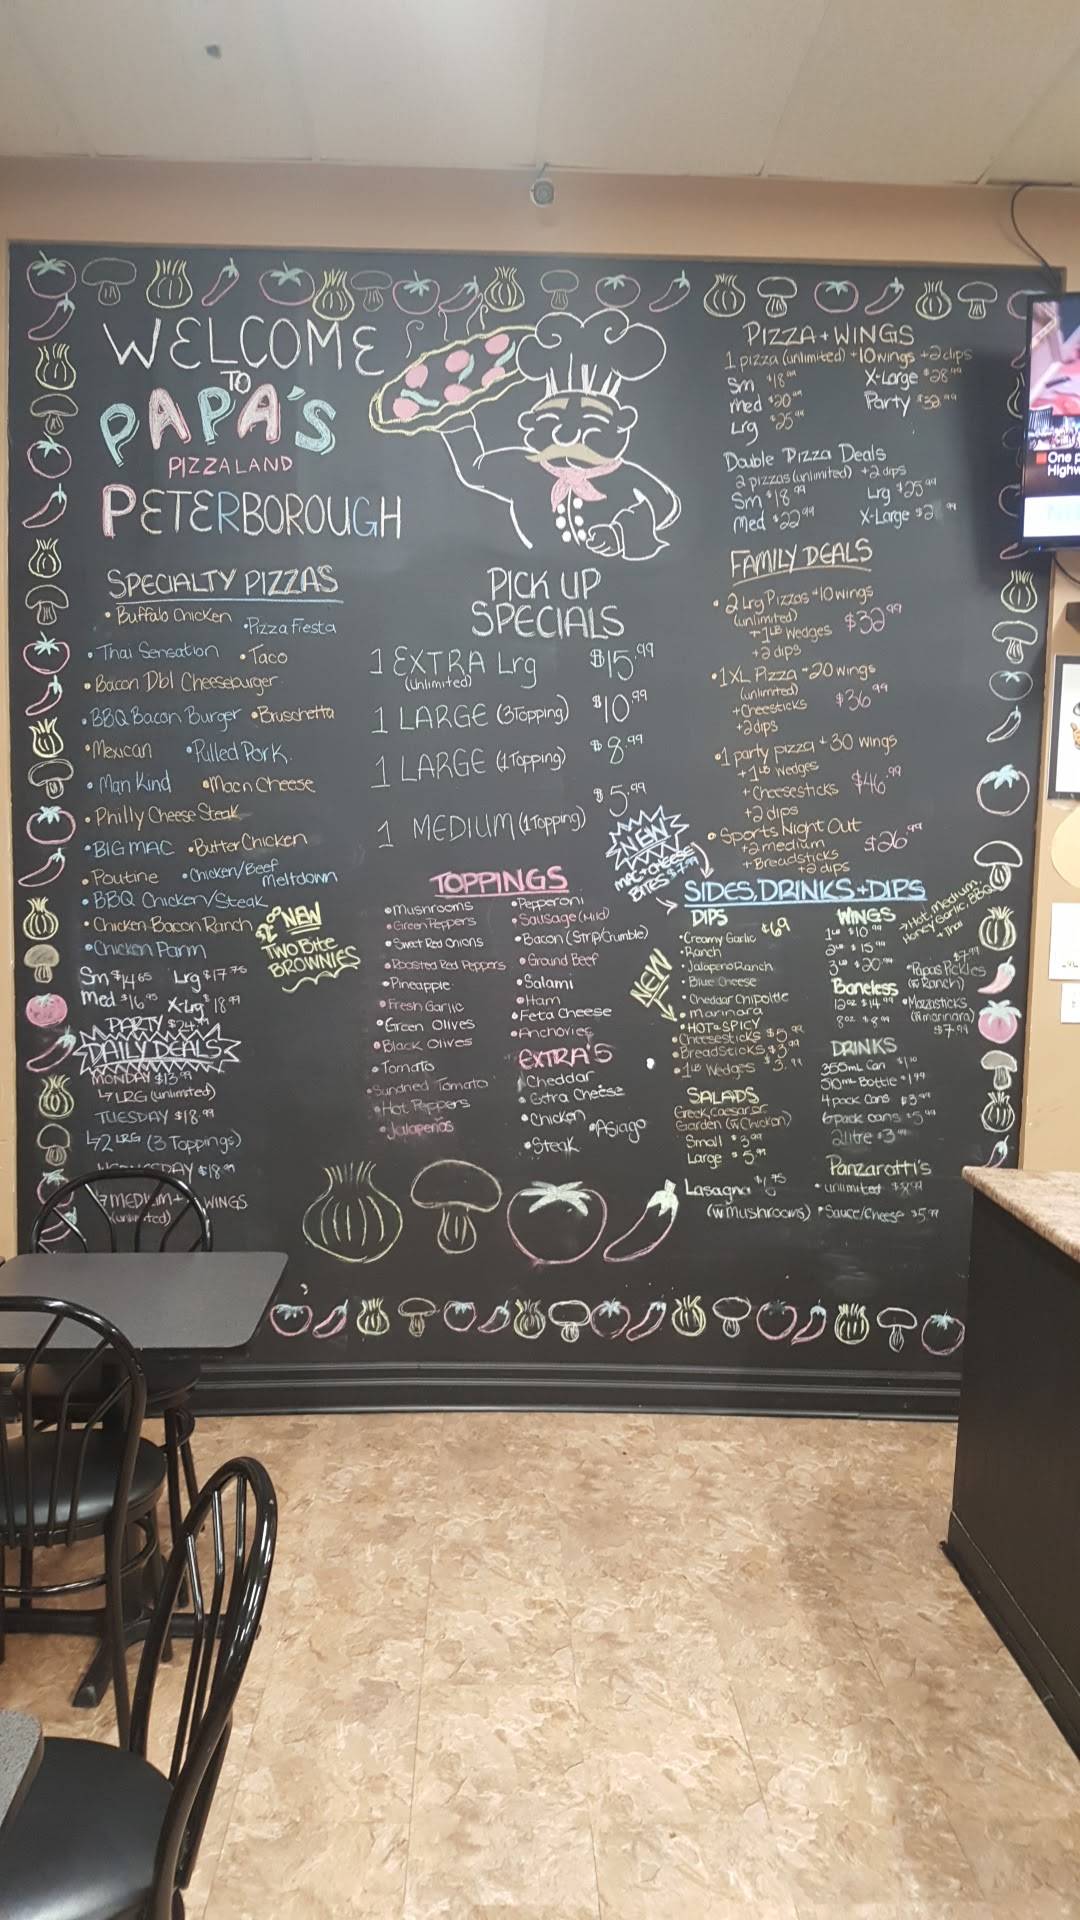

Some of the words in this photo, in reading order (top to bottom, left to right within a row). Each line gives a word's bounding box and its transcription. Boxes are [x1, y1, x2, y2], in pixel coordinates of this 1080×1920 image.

[743, 321, 816, 346] PIZZA
[834, 324, 915, 346] WINGS
[103, 316, 384, 376] WELCOME
[739, 355, 779, 372] pizza
[220, 369, 250, 394] TO
[864, 368, 919, 391] X-Large
[864, 390, 911, 417] Party
[100, 384, 337, 467] PAPA'S
[168, 456, 293, 478] PIZZALAND
[723, 450, 774, 472] Double
[782, 447, 832, 463] Pizza
[839, 443, 887, 463] Deals
[1047, 451, 1072, 465] One
[102, 484, 401, 539] PETERBOROUGH
[860, 507, 910, 530] X-Large
[730, 547, 798, 579] FAMILY
[805, 538, 873, 566] DEALS
[107, 568, 237, 599] SPECIALTY
[245, 565, 339, 595] PIZZAS
[486, 567, 550, 602] PICK
[561, 567, 601, 600] UP
[725, 593, 738, 614] 2
[764, 589, 809, 607] Pizzas
[117, 606, 168, 625] Buffalo
[173, 607, 232, 624] Chicken
[471, 600, 625, 640] SPECIALS
[248, 617, 288, 635] Pizza
[96, 643, 133, 661] Thai
[139, 641, 220, 659] Sensation
[248, 644, 288, 664] Taco
[773, 644, 801, 661] dips
[369, 647, 383, 675] 1
[393, 646, 486, 677] EXTRA
[497, 651, 537, 689] Lrg
[590, 642, 654, 681] $15.99
[95, 674, 139, 693] Bacon
[143, 671, 174, 692] Dbl
[181, 671, 279, 697] Cheeseburger
[90, 707, 129, 729] BBQ
[131, 706, 182, 726] Bacon
[185, 706, 242, 732] Burger
[257, 705, 336, 725] Bruschetta
[371, 706, 389, 734] 1
[400, 703, 489, 730] LARGE
[592, 689, 648, 724] $10.99
[92, 740, 153, 760] Mexican
[192, 739, 240, 763] Pulled
[241, 741, 288, 764] Pork
[734, 744, 769, 768] party
[774, 740, 815, 763] pizza
[370, 755, 391, 789] 1
[401, 748, 486, 782] LARGE
[99, 774, 131, 796] Man
[136, 770, 172, 793] Kind
[256, 777, 316, 793] Cheese
[95, 806, 144, 832] Philly
[149, 806, 197, 824] Cheese
[198, 803, 241, 822] Steak
[377, 820, 394, 848] 1
[413, 812, 516, 842] MEDIUM
[619, 817, 672, 855] NEW
[720, 825, 779, 845] Sports
[782, 821, 824, 841] Night
[828, 818, 863, 834] Out
[93, 840, 125, 859] BIG
[130, 840, 176, 857] MAC
[194, 838, 240, 857] Butter
[241, 833, 308, 851] Chicken
[91, 868, 160, 887] Poutine
[430, 866, 569, 894] TOPPINGS
[628, 873, 670, 902] BITES
[758, 877, 855, 900] DRINKS
[866, 878, 926, 899] DIPS
[93, 890, 136, 910] BBQ
[391, 901, 474, 916] Mushrooms
[516, 896, 584, 911] Pepperoni
[93, 917, 147, 933] Chicken
[150, 915, 202, 935] Bacon
[202, 915, 253, 933] Ranch
[281, 902, 323, 929] NEW
[393, 921, 428, 931] Green
[429, 916, 477, 931] Peppers
[519, 912, 577, 926] Sausage
[691, 908, 728, 927] DIPS
[837, 907, 896, 926] WINGS
[426, 938, 443, 948] Red
[445, 936, 484, 949] Onions
[522, 932, 564, 947] Bacon
[684, 931, 723, 947] Creamy
[726, 931, 756, 943] Garlic
[93, 941, 153, 957] Chicken
[156, 941, 207, 959] Parm
[528, 953, 568, 967] Ground
[570, 952, 599, 966] Beef
[685, 946, 721, 957] Ranch
[267, 950, 361, 979] BROWNIES
[392, 959, 438, 971] Roasted
[439, 960, 459, 970] Red
[462, 959, 506, 972] Peppers
[390, 977, 451, 992] Pineapple
[524, 975, 574, 990] Salami
[629, 948, 673, 1008] NEW
[689, 976, 716, 987] Blue
[718, 976, 757, 987] Cheese
[831, 978, 899, 996] Boneless
[388, 1000, 423, 1012] Fresh
[425, 998, 464, 1014] Garlic
[524, 994, 561, 1006] Ham
[520, 1008, 555, 1022] Feta
[558, 1006, 613, 1019] Cheese
[104, 1015, 164, 1033] PARTY
[384, 1017, 424, 1034] Green
[431, 1015, 476, 1030] Olives
[518, 1025, 593, 1039] Anchovies
[722, 1017, 761, 1033] SPICY
[87, 1039, 148, 1067] DAILY
[152, 1038, 222, 1060] DEALS
[382, 1039, 423, 1052] Black
[427, 1037, 473, 1050] Olives
[831, 1037, 898, 1057] DRINKS
[381, 1060, 436, 1074] Tomato
[91, 1072, 151, 1085] MONDAY
[436, 1077, 489, 1091] Tomato
[526, 1071, 597, 1089] Cheddar
[115, 1090, 148, 1103] LRG
[573, 1085, 626, 1101] Cheese
[687, 1086, 760, 1104] SALADS
[95, 1110, 169, 1125] TUESDAY
[382, 1100, 409, 1116] Hot
[530, 1109, 586, 1127] Chicken
[676, 1115, 722, 1130] Garden
[116, 1133, 142, 1144] LRG
[532, 1136, 580, 1153] Steak
[685, 1134, 723, 1149] Small
[687, 1152, 723, 1169] Large
[826, 1154, 932, 1176] Panzarotti's
[685, 1177, 751, 1204] Lasagna
[204, 1194, 248, 1210] WINGS
